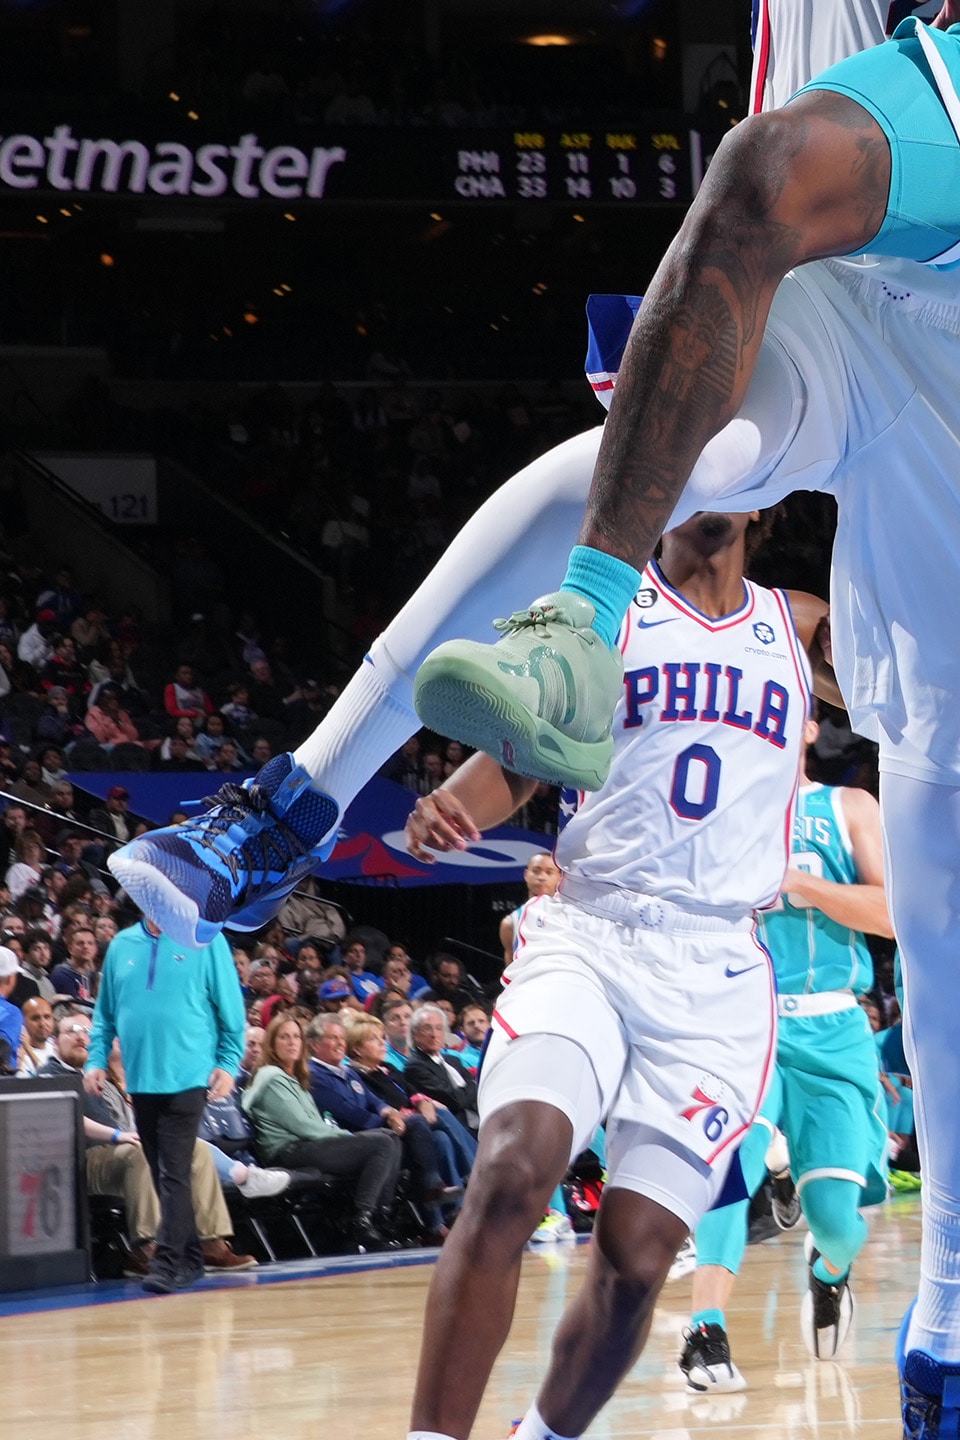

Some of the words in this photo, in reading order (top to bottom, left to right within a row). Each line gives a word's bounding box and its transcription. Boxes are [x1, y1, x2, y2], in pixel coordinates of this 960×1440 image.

[0, 124, 347, 199] etmaster
[616, 152, 629, 174] 1
[109, 493, 148, 519] 121
[623, 662, 790, 750] PHILA
[670, 743, 722, 821] 0
[679, 1085, 729, 1142] 76
